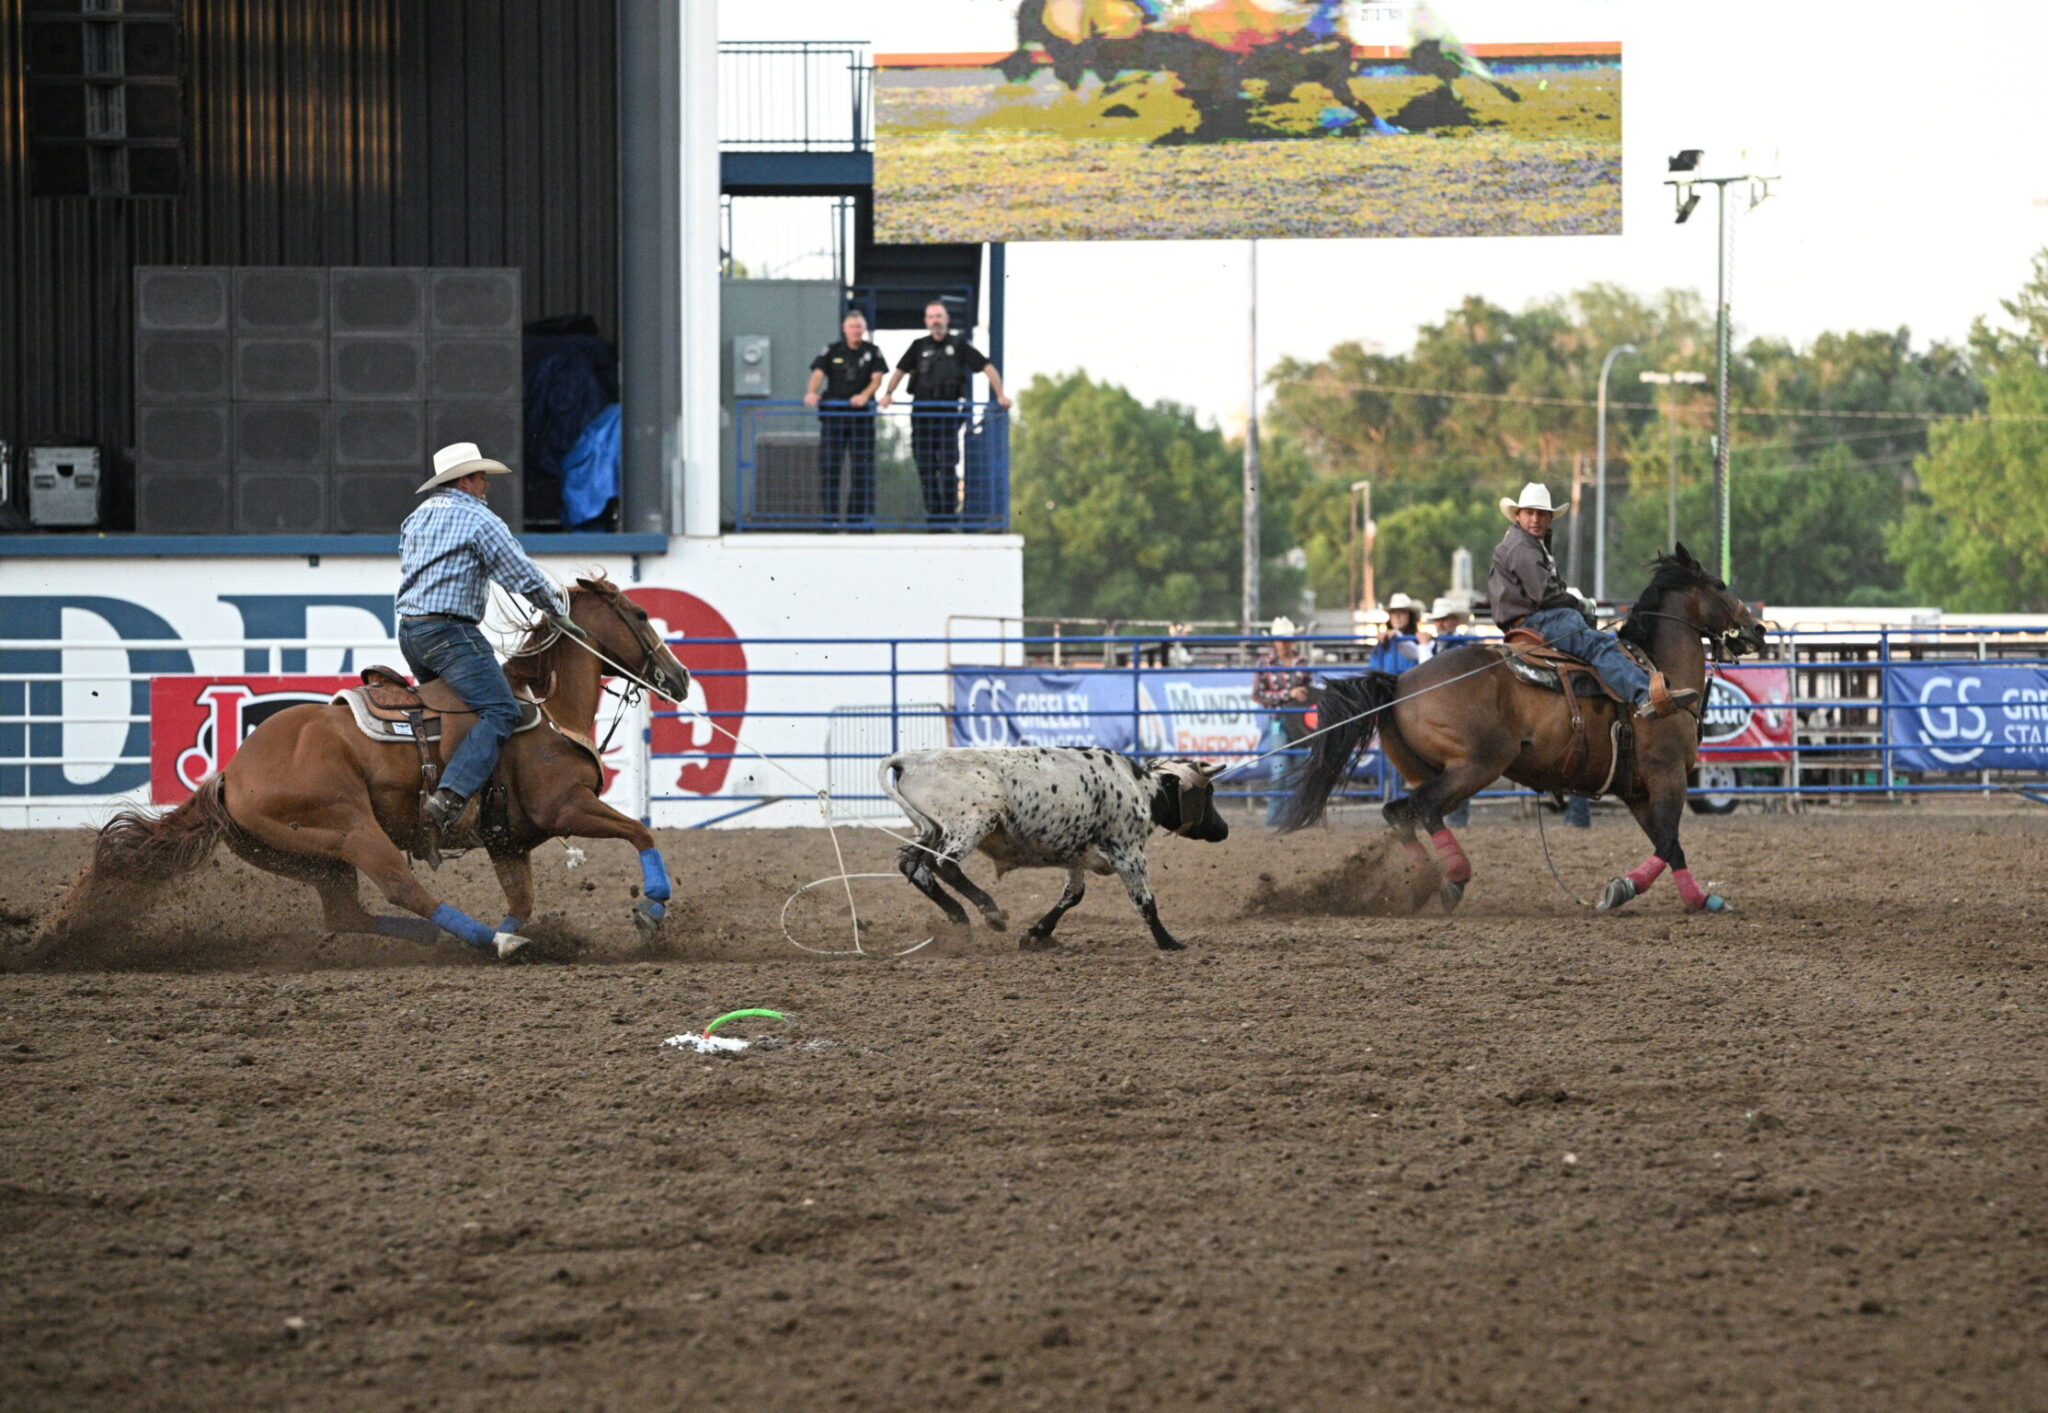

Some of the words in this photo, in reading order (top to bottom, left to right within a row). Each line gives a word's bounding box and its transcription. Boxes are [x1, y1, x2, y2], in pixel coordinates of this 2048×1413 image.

[968, 678, 1009, 746] GS
[1016, 692, 1090, 730] GREELEY
[1920, 676, 1987, 740] GS
[2004, 724, 2048, 754] STA
